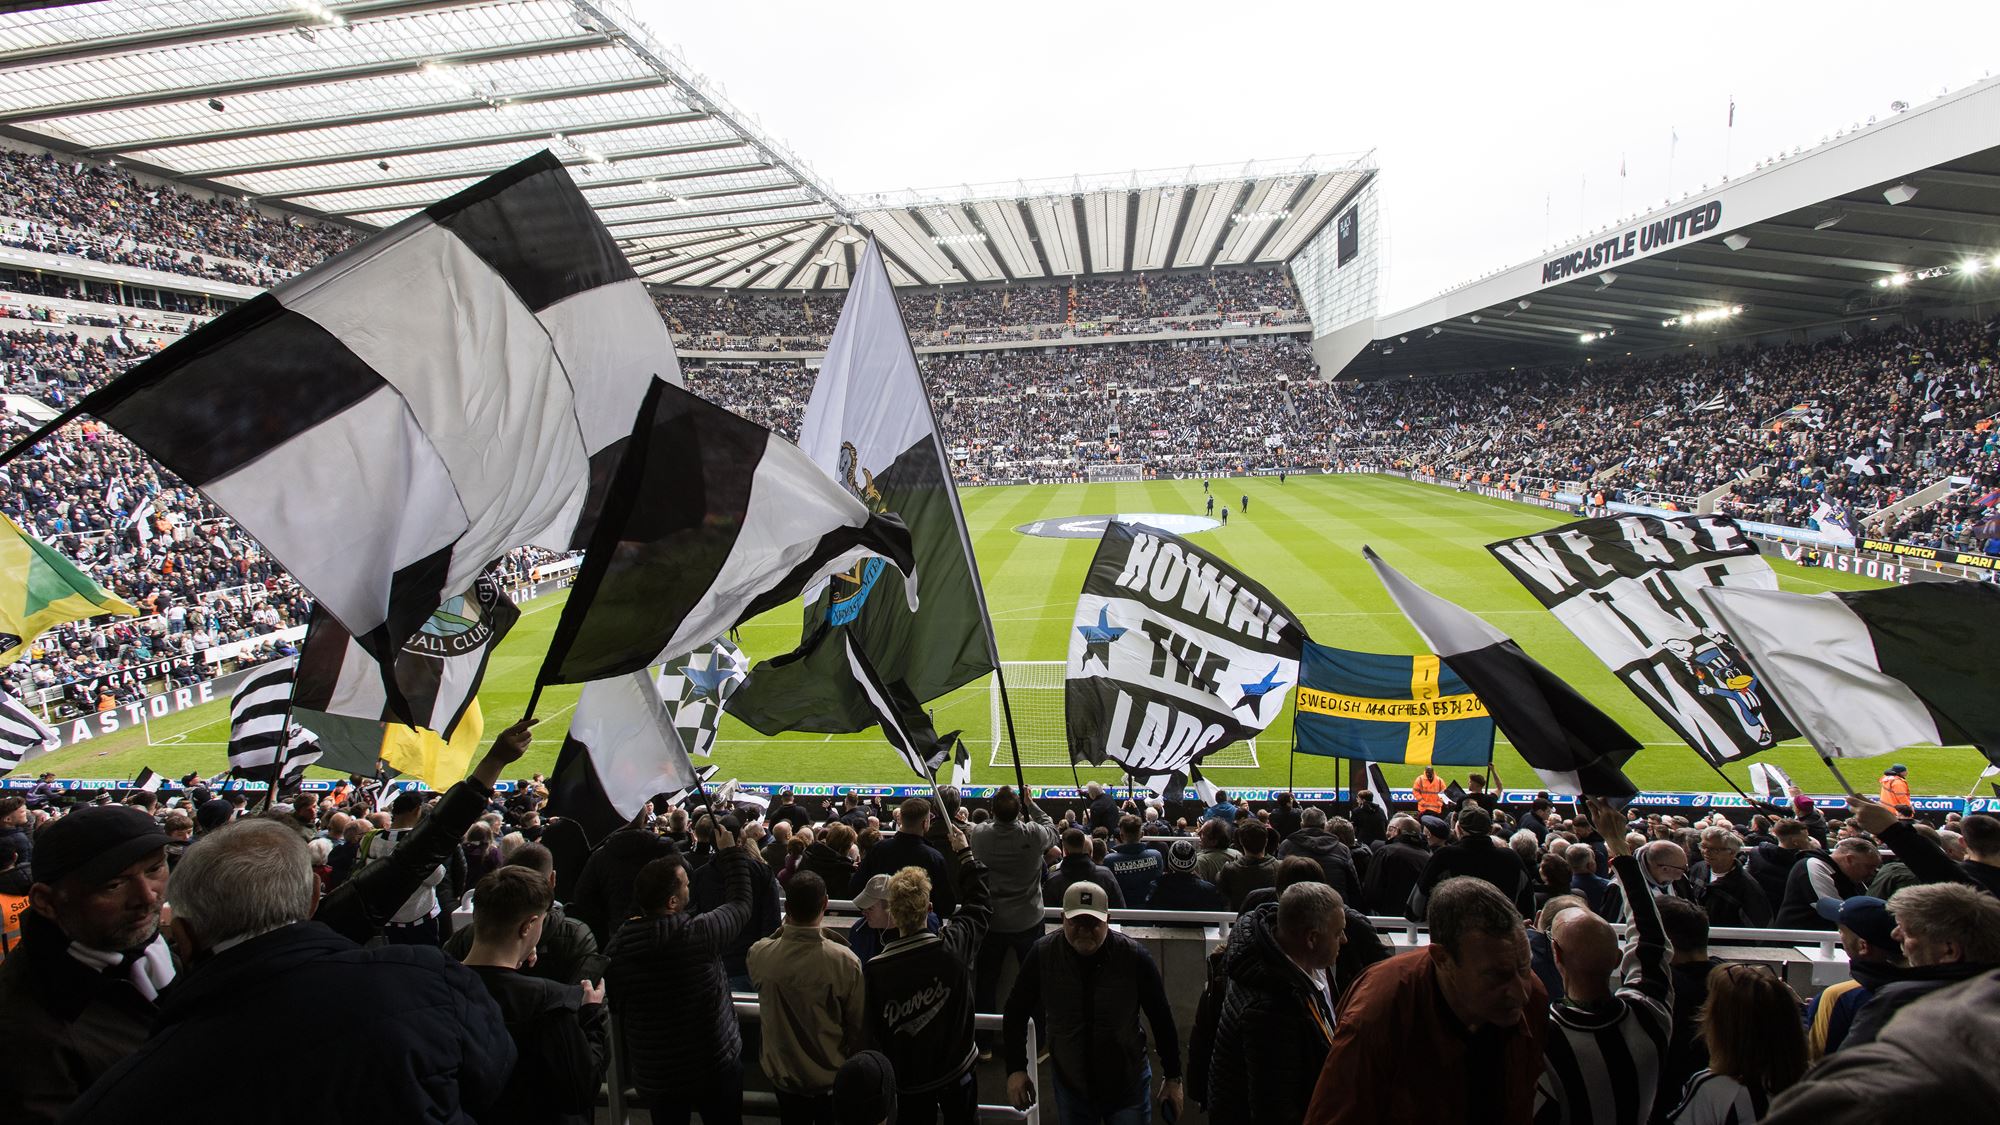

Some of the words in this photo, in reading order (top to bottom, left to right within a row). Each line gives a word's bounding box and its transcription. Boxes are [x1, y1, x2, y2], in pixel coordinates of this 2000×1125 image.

[1542, 230, 1636, 284] NEWCASTLE
[1640, 200, 1722, 252] UNITED
[1043, 477, 1084, 485] CASTORE
[1188, 472, 1231, 480] CASTORE
[1495, 529, 1618, 595] WE
[1617, 517, 1749, 563] ARE
[1865, 540, 1892, 552] PARI
[1896, 545, 1936, 559] MATCH
[1818, 552, 1911, 584] ASTORE
[1958, 554, 1993, 568] PARI
[453, 622, 489, 650] CLUB
[1141, 618, 1230, 694] THE
[1300, 693, 1361, 713] SWEDISH
[1466, 699, 1482, 712] 20
[1106, 689, 1225, 770] LADS
[83, 780, 115, 789] NIXON
[793, 786, 834, 795] NIXON
[11, 897, 29, 912] Saf
[883, 977, 945, 1028] Dave's
